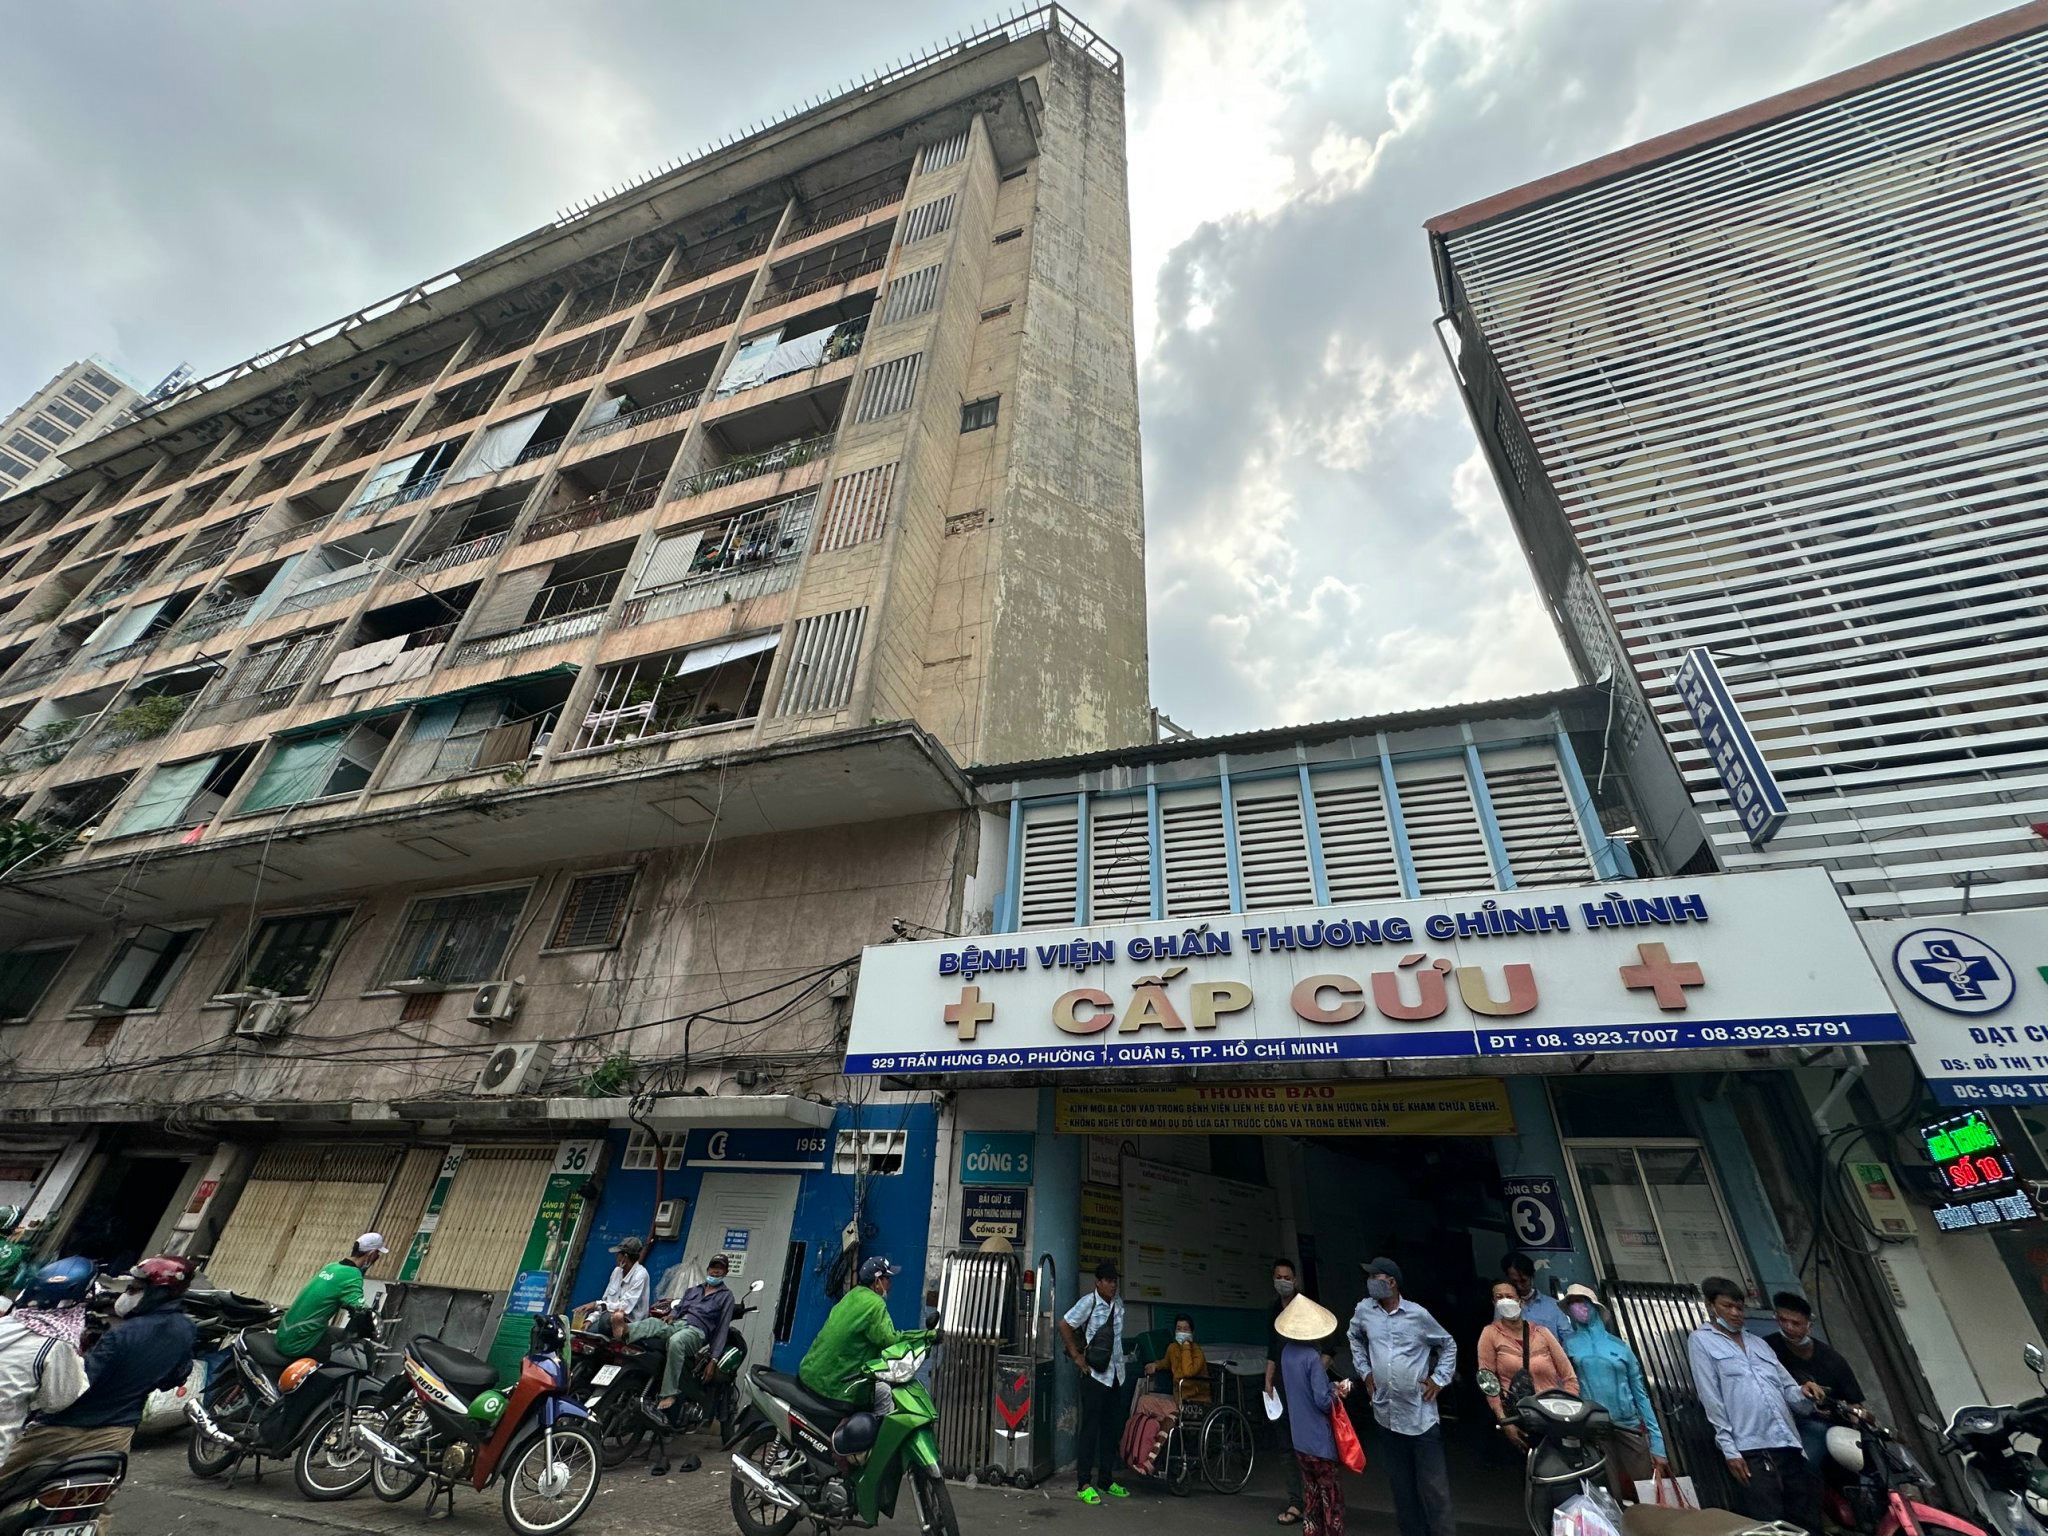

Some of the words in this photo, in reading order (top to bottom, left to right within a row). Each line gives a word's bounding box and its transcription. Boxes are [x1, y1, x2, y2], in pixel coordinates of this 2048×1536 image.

[939, 945, 1028, 979] BỆNH
[1036, 938, 1115, 972] VIỆN
[1127, 923, 1232, 960] CHẤN
[1242, 918, 1413, 952] THƯƠNG
[1425, 900, 1569, 940] CHỈNH
[1580, 891, 1709, 929] HÌNH
[1052, 966, 1254, 1035] CẤP
[1291, 953, 1539, 1023] CỨU
[1489, 1034, 1518, 1049] ĐT
[1536, 1033, 1568, 1048] 08.
[1574, 1028, 1680, 1046] 3923.7007
[1701, 1021, 1853, 1042] 08.3923.5791
[1968, 1026, 2019, 1047] ĐẠT
[871, 1056, 895, 1069] 929
[898, 1052, 938, 1068] TRẦN
[941, 1054, 983, 1067] HƯNG
[987, 1053, 1024, 1067] ĐẠO,
[1028, 1049, 1096, 1064] PHƯỜNG
[1100, 1049, 1114, 1063] 1,
[1118, 1045, 1167, 1062] QUẬN
[1171, 1047, 1186, 1061] 5,
[1190, 1045, 1218, 1059] TP.
[1222, 1040, 1249, 1057] HỒ
[1254, 1041, 1286, 1058] CHÍ
[1291, 1041, 1339, 1056] MINH
[1940, 1058, 1971, 1071] DS:
[1973, 1053, 1998, 1070] ĐỖ
[2000, 1057, 2032, 1071] THỊ
[1952, 1084, 1985, 1099] ĐC:
[1990, 1084, 2027, 1098] 943
[796, 1138, 826, 1152] 1963
[443, 1155, 460, 1171] 36
[561, 1147, 588, 1171] 36
[966, 1143, 1012, 1172] CỔNG
[1017, 1153, 1029, 1172] 3
[1949, 1155, 1979, 1187] SỐ
[1976, 1157, 2003, 1181] 10
[1532, 1181, 1551, 1194] SỐ
[1003, 1195, 1012, 1205] XE
[1516, 1200, 1547, 1242] 3
[415, 1375, 450, 1403] REPSOL
[798, 1430, 829, 1451] DUNLOP
